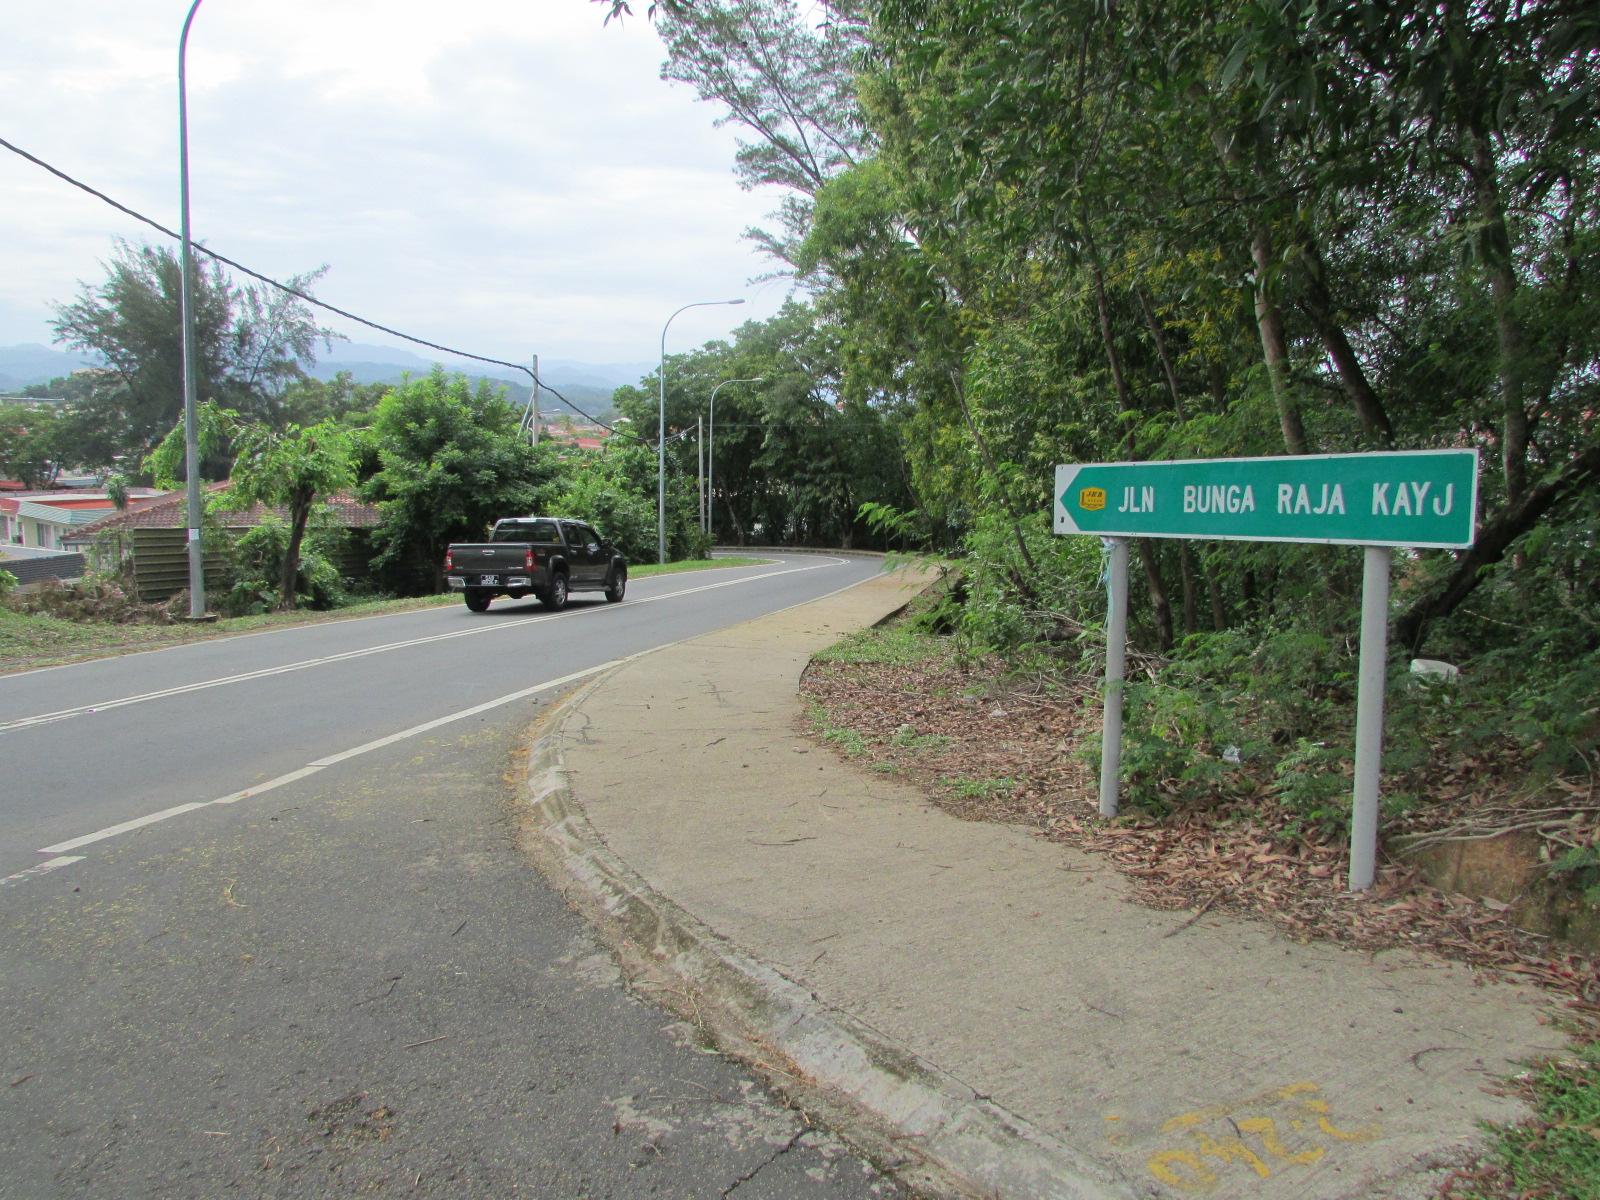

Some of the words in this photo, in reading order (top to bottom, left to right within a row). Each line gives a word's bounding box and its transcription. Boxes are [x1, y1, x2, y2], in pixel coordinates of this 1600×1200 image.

[1118, 486, 1154, 512] JLN
[1184, 485, 1255, 513] BUNGA
[1278, 484, 1345, 514] RAJA
